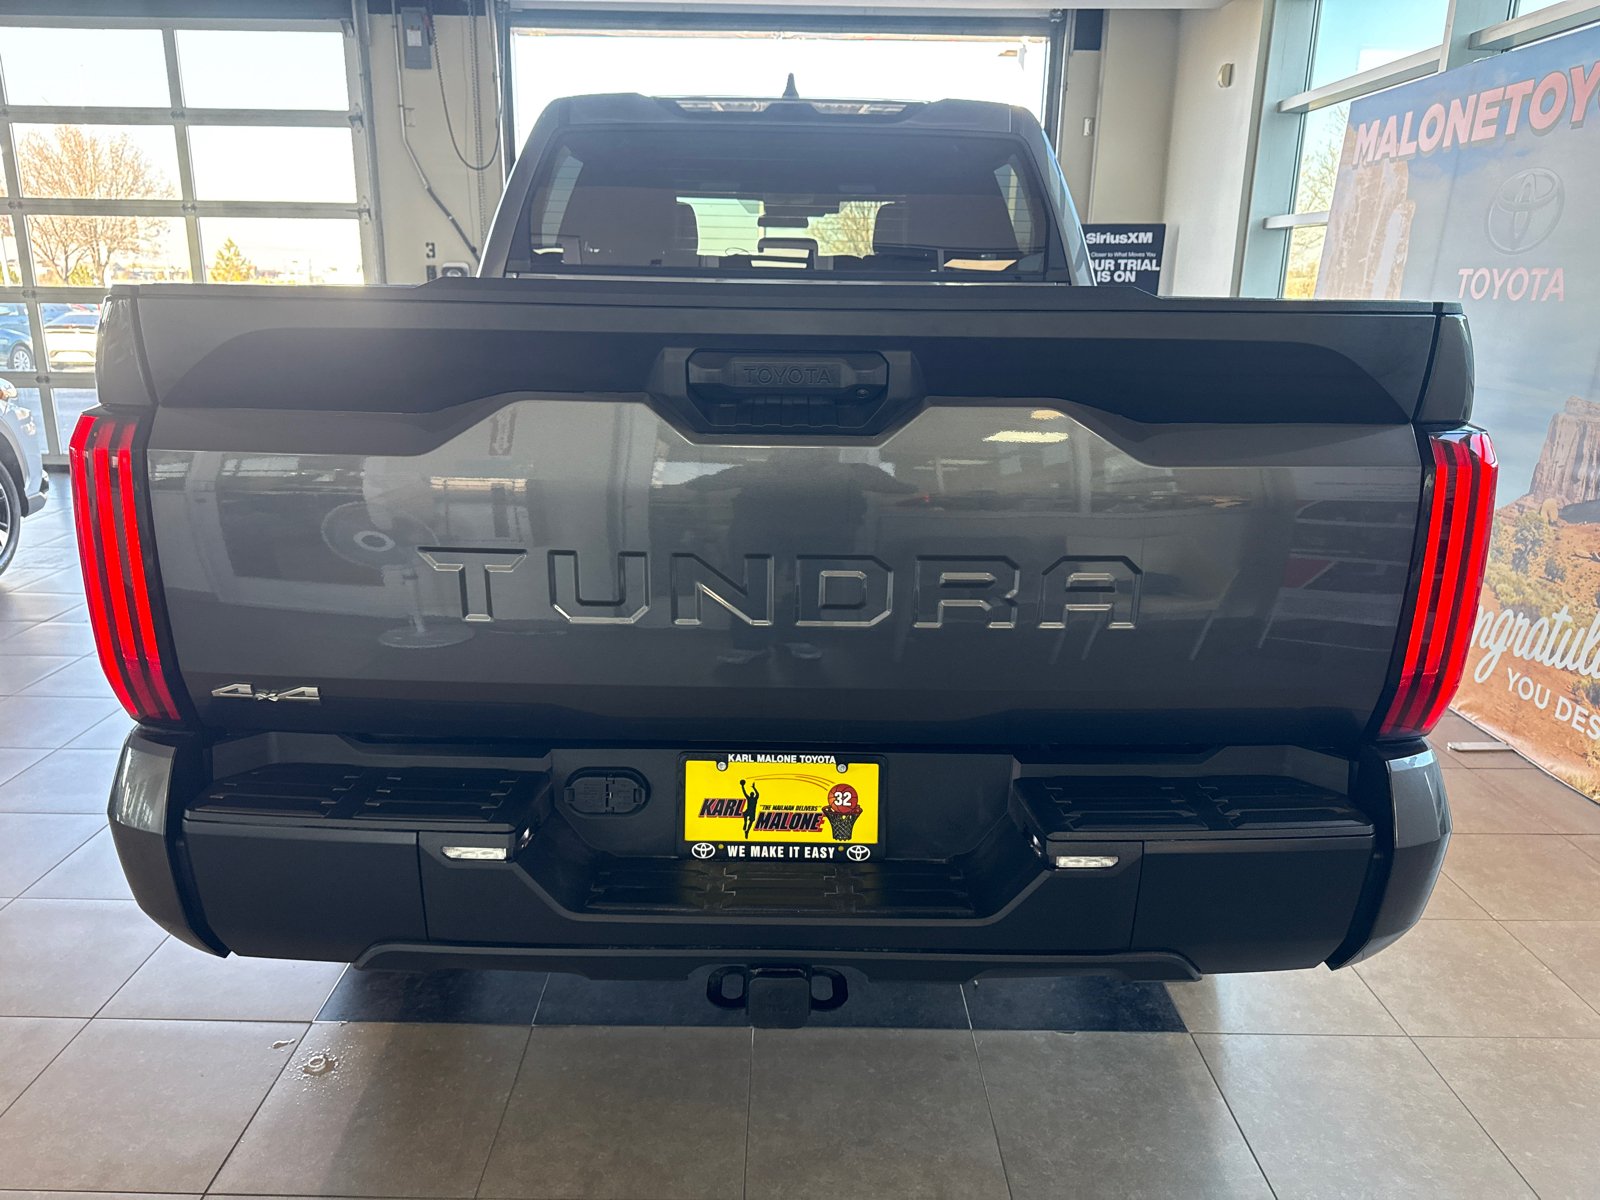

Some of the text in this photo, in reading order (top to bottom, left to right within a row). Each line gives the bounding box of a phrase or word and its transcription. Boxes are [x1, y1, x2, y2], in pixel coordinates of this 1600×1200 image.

[1351, 60, 1600, 169] MALONETOY
[1086, 232, 1153, 244] SiriusXM
[425, 242, 436, 259] 3
[1117, 259, 1160, 271] TRIAL
[1097, 271, 1136, 283] IS ON
[1458, 267, 1565, 302] TOYOTA
[742, 366, 833, 384] TOYOTA
[417, 546, 1143, 629] TUNDRA
[1507, 667, 1551, 709] YOU
[728, 754, 836, 764] KARL MALONE TOYOTA
[834, 791, 852, 807] 32
[698, 798, 747, 818] KARL
[753, 812, 825, 832] MALONE
[728, 845, 835, 859] WE MAKE IT EASY
